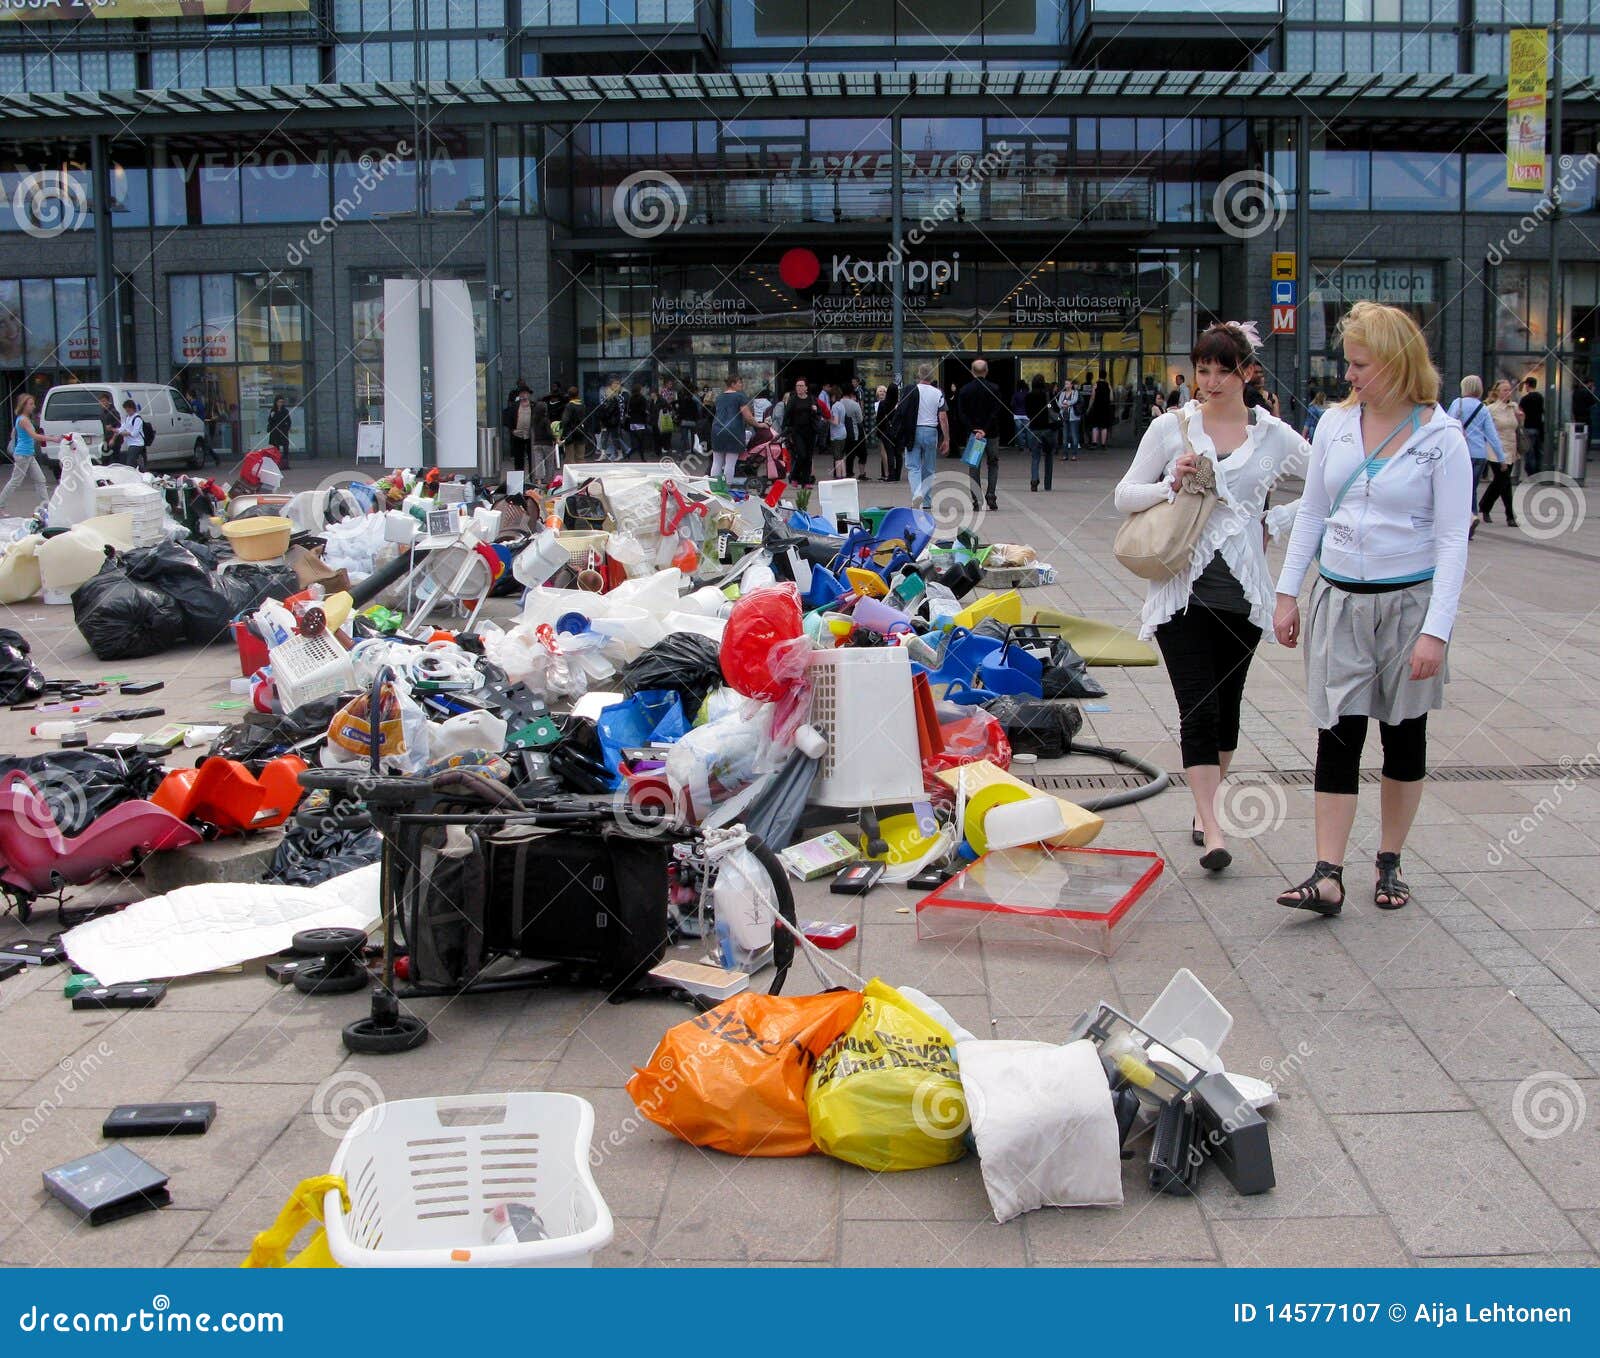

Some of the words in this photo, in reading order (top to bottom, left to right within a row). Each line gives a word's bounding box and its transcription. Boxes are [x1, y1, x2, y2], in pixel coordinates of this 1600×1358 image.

[172, 150, 297, 184] VERO
[832, 251, 959, 290] Kamppi
[1332, 270, 1424, 290] emotion
[651, 296, 746, 310] Metroasema
[1016, 294, 1141, 311] Linja-autoasema
[651, 311, 748, 325] Metrostation
[1016, 309, 1097, 323] Busstation
[1273, 308, 1295, 329] M
